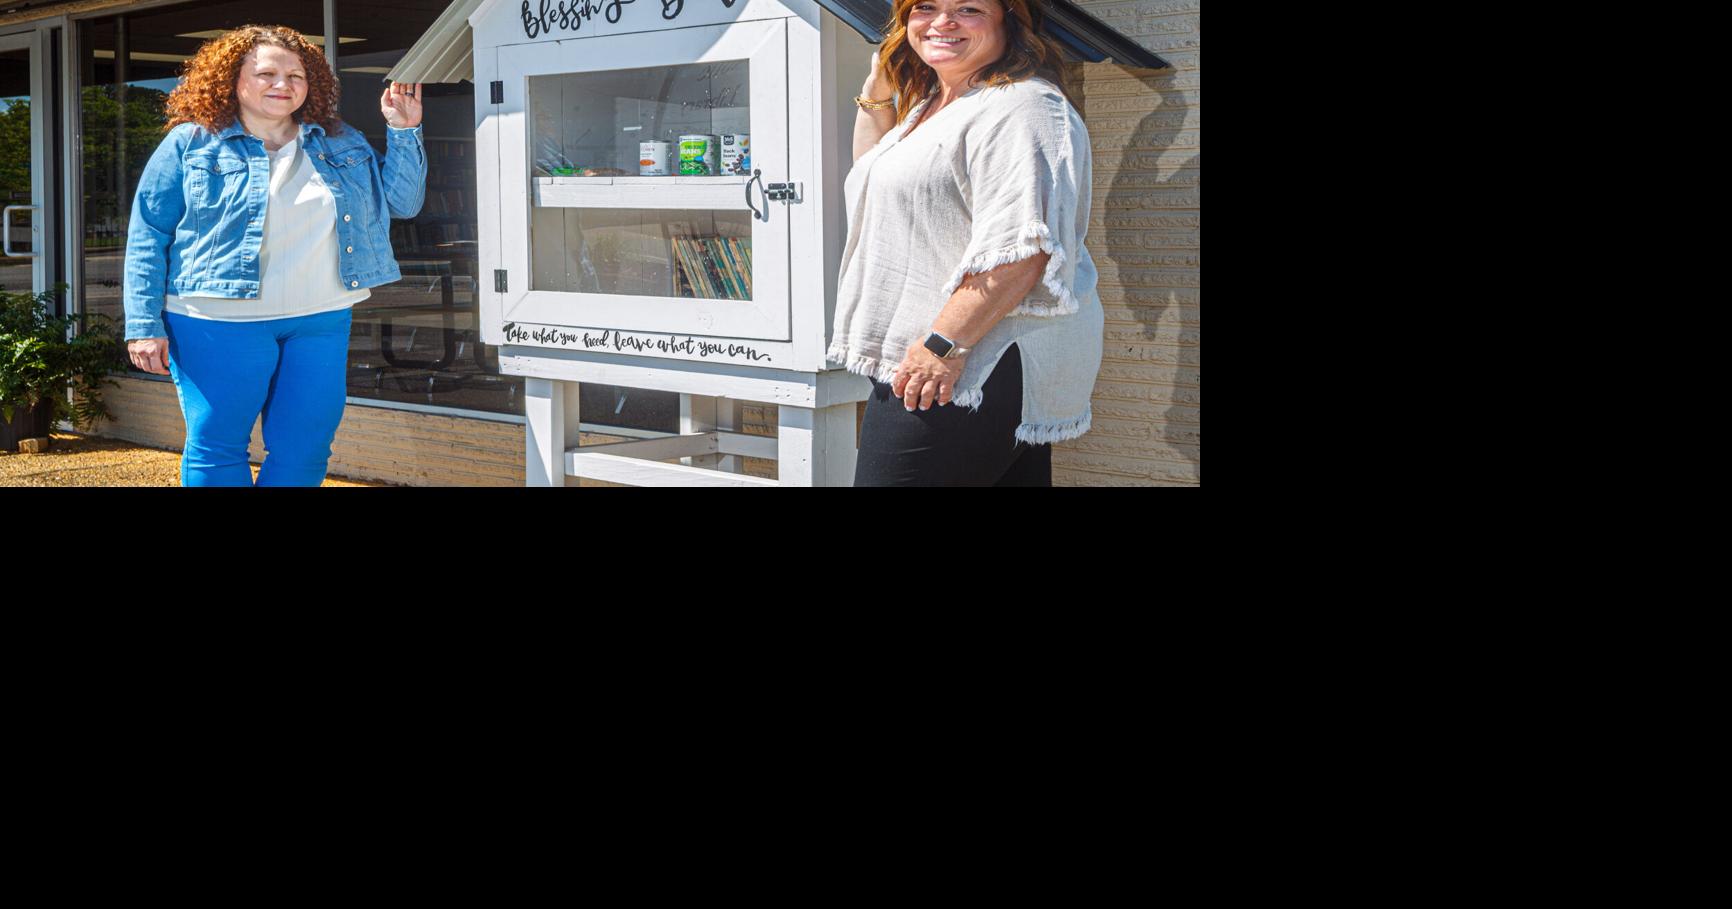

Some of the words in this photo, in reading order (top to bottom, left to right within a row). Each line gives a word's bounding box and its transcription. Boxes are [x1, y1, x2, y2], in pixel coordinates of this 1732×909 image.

[502, 321, 529, 343] Take
[532, 327, 559, 345] what
[559, 331, 578, 346] you
[613, 330, 654, 352] leave
[656, 335, 695, 354] what
[697, 340, 727, 358] you
[727, 343, 773, 362] can.
